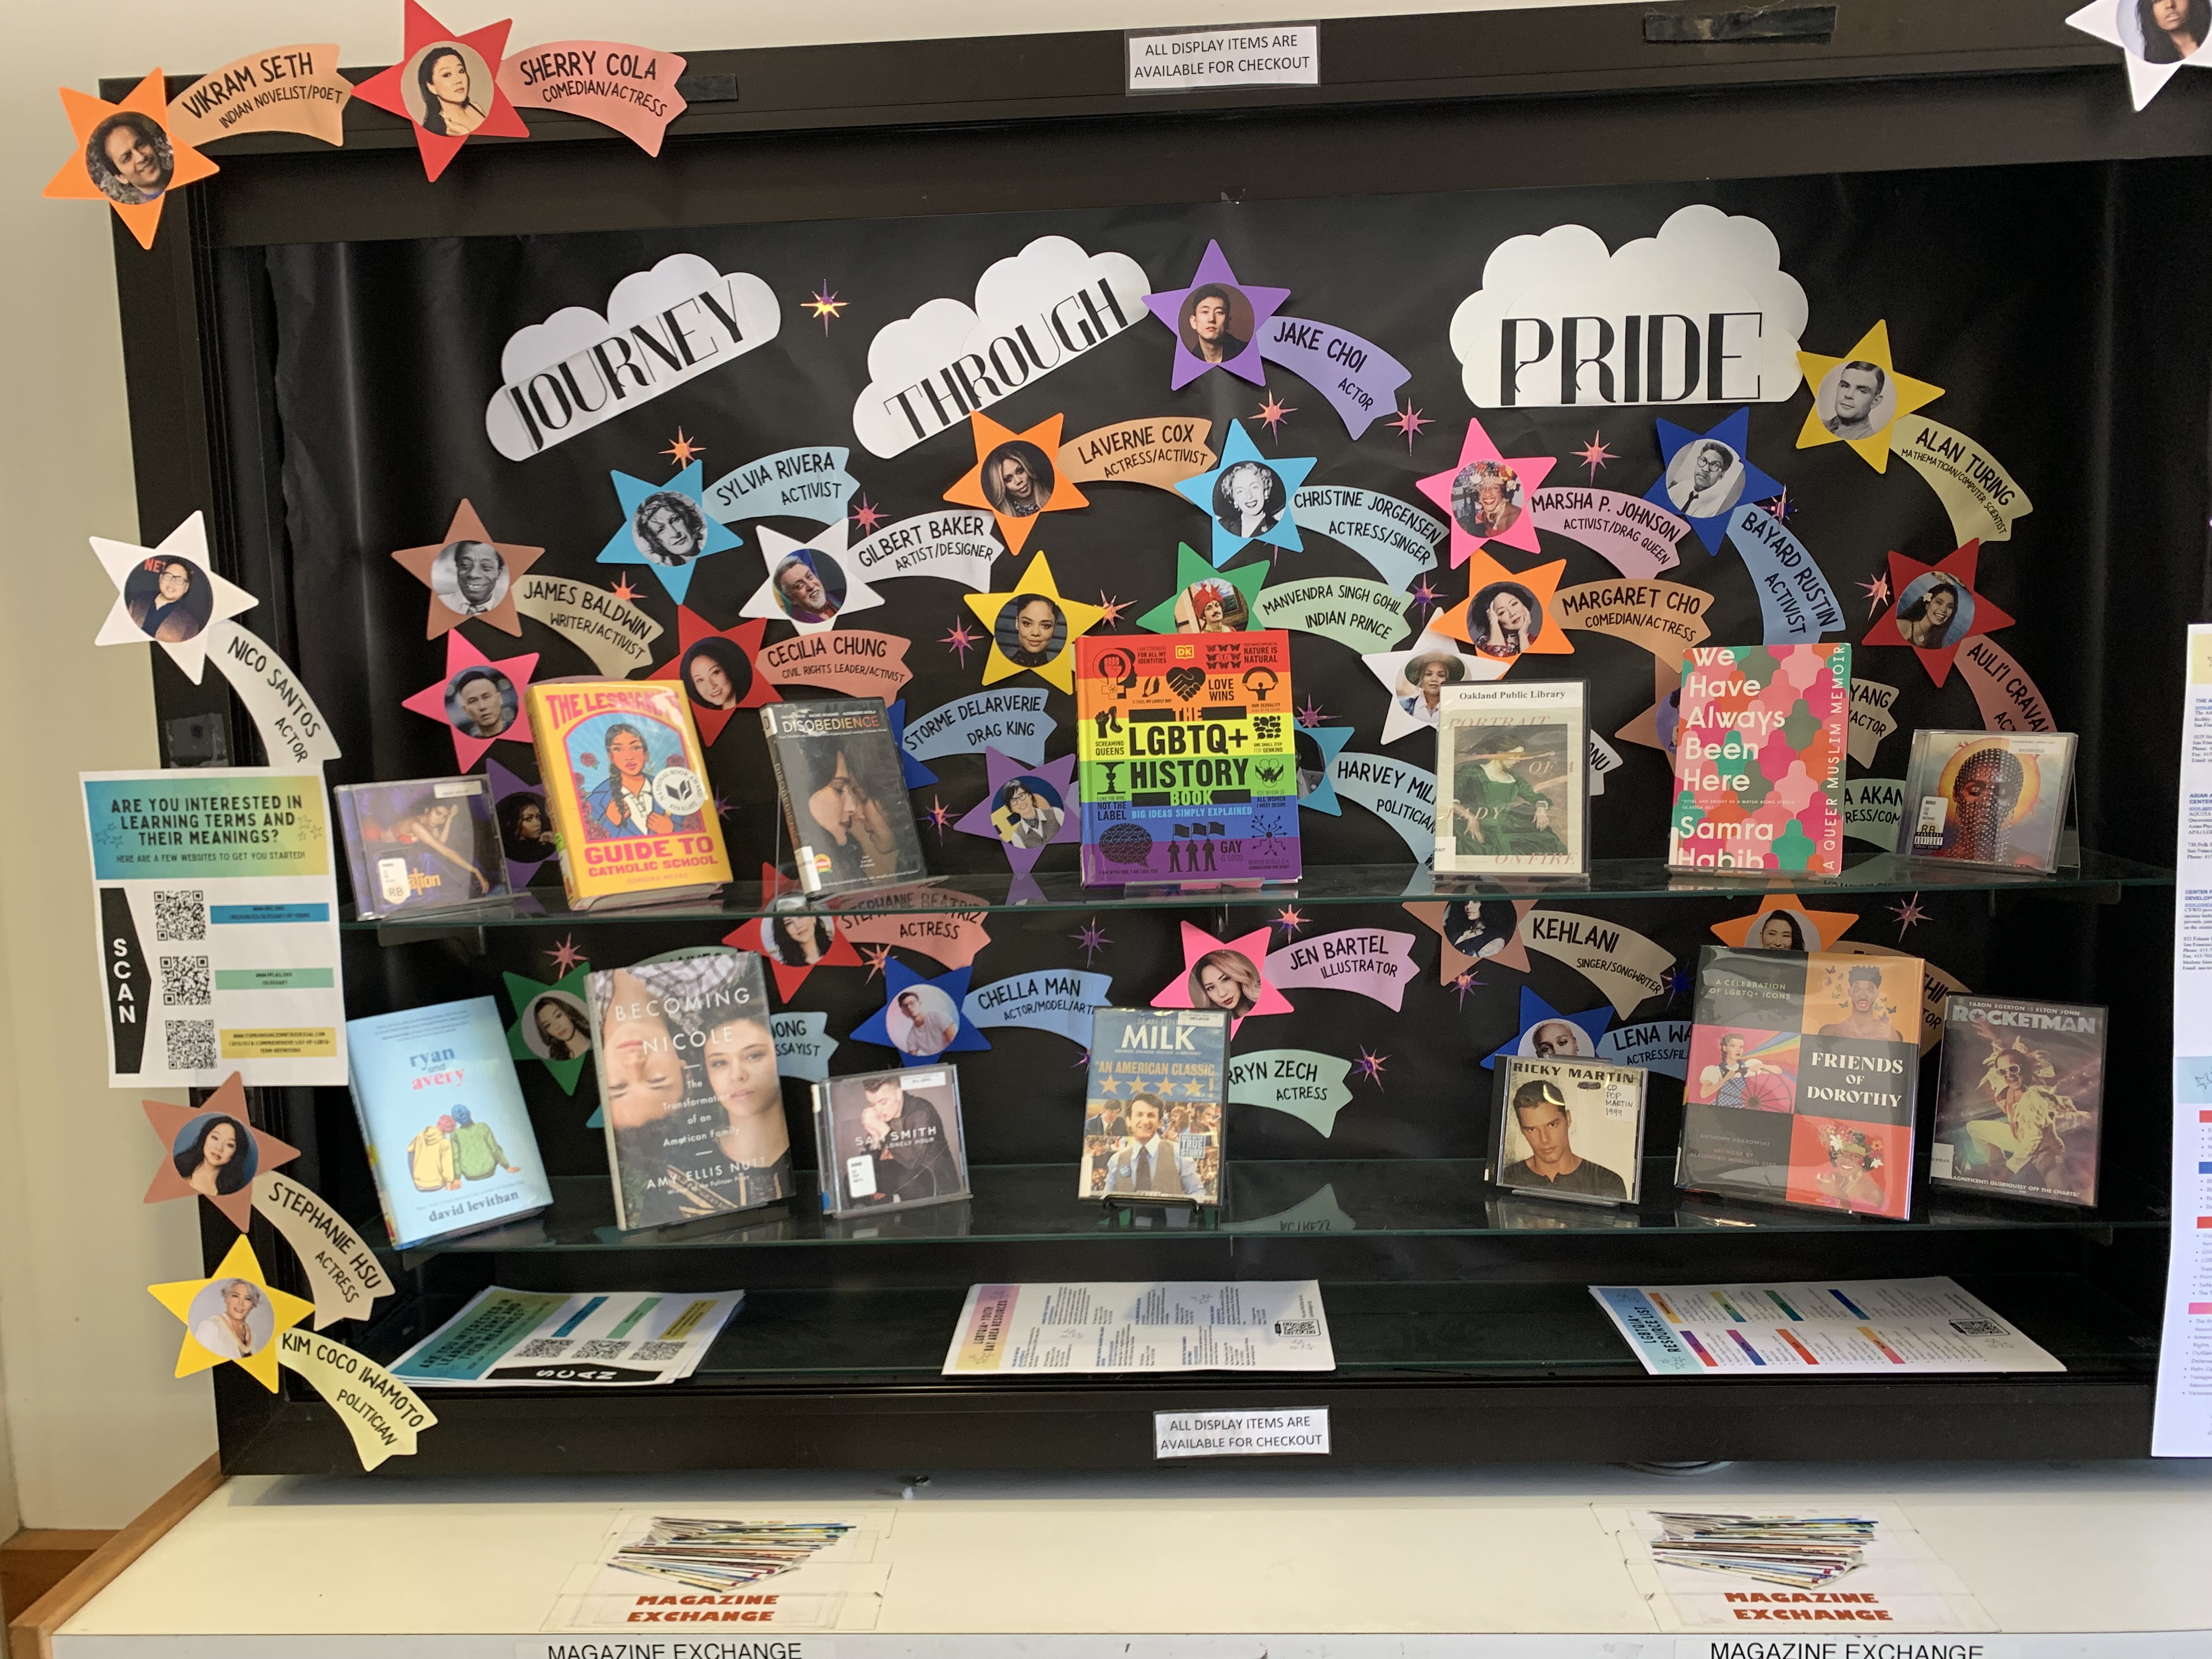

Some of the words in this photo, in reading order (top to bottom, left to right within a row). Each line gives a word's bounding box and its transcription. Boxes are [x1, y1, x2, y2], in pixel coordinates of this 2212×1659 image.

[1146, 44, 1167, 55] ALL
[1172, 39, 1223, 54] DISPLAY
[1228, 37, 1268, 49] ITEMS
[1273, 35, 1297, 47] ARE
[520, 50, 596, 87] SHERRY
[606, 52, 657, 80] COLA
[1135, 63, 1204, 77] AVAILABLE
[1209, 61, 1234, 74] FOR
[1239, 57, 1310, 71] CHECKOUT
[181, 67, 256, 120] VIKRAM
[259, 54, 313, 83] SETH
[543, 80, 667, 119] COMEDIAN/ACTRESS
[219, 103, 253, 129] INDIAN
[253, 84, 342, 114] NOVELIST/POET
[883, 278, 1128, 440] THROUGH
[1274, 321, 1321, 352] JAKE
[1327, 332, 1368, 373] CHOI
[1500, 312, 1763, 406] PRIDE
[510, 280, 743, 452] JOURNEY
[1338, 377, 1374, 411] ACTOR
[1079, 426, 1155, 465] LAVERNE
[1162, 424, 1194, 443] COX
[1103, 448, 1207, 478] ACTRESS/ACTIVIST
[1916, 427, 1966, 464] ALAN
[1965, 454, 2015, 506] TURING
[716, 467, 770, 506] SYLVIA
[775, 453, 835, 481] RIVERA
[781, 482, 842, 505] ACTIVIST
[1901, 448, 1986, 504] MATHEMATICIAN/COMPUTER
[1983, 502, 2006, 535] SCIENTIST
[1294, 492, 1363, 509] CHRISTINE
[1368, 498, 1443, 545] JORGENSEN
[1531, 493, 1593, 512] MARSHA
[1598, 496, 1611, 512] P.
[1616, 501, 1680, 543] JOHNSON
[859, 526, 923, 567] GILBERT
[931, 515, 984, 540] BAKER
[1328, 521, 1431, 566] ACTRESS/SINGER
[1564, 518, 1639, 543] ACTIVIST/DRAG
[1640, 537, 1671, 565] QUEEN
[895, 544, 994, 572] ARTIST/DESIGNER
[1741, 511, 1802, 569] BAYARD
[1793, 566, 1839, 628] RUSTIN
[523, 580, 576, 605] JAMES
[581, 590, 652, 640] BALDWIN
[1262, 585, 1333, 616] MANVENDRA
[1338, 585, 1370, 601] SINGH
[1373, 592, 1403, 616] GOHIL
[1562, 586, 1662, 616] MARGARET
[1666, 591, 1701, 615] CHO
[1764, 572, 1807, 634] ACTIVIST
[550, 612, 646, 659] WRITER/ACTIVIST
[1305, 612, 1346, 629] INDIAN
[1351, 614, 1393, 640] PRINCE
[1585, 613, 1696, 641] COMEDIAN/ACTRESS
[768, 639, 827, 667] CECILIA
[834, 637, 887, 658] CHUNG
[1244, 654, 1278, 663] NATURAL
[1692, 648, 1735, 667] We
[227, 636, 266, 672] NICO
[267, 669, 321, 737] SANTOS
[782, 667, 801, 679] CIVIL
[803, 664, 832, 675] RIGHTS
[834, 664, 905, 683] LEADER/ACTIVIST
[1209, 679, 1234, 690] LOVE
[1689, 675, 1760, 697] Have
[1831, 646, 1845, 713] MEMOIR
[1210, 691, 1234, 701] WINS
[1459, 691, 1497, 701] Oakland
[1500, 691, 1528, 699] Public
[1530, 690, 1565, 699] Library
[782, 715, 879, 732] DISOBEDIENCE
[904, 708, 956, 751] STORME
[961, 695, 1041, 720] DELARVERIE
[967, 723, 1002, 746] DRAG
[1006, 721, 1034, 736] KING
[1686, 707, 1785, 735] Always
[274, 717, 308, 763] ACTOR
[1096, 747, 1124, 756] QUEENS
[1128, 724, 1248, 756] LGBTQ+
[1685, 738, 1758, 760] Been
[1827, 723, 1842, 789] MUSLIM
[1131, 759, 1249, 789] HISTORY
[1684, 768, 1750, 791] Here
[111, 799, 142, 813] ARE
[149, 797, 180, 812] YOU
[185, 795, 281, 810] INTERESTED
[286, 795, 302, 809] IN
[1132, 810, 1147, 819] BIG
[1148, 809, 1174, 819] IDEAS
[1176, 809, 1205, 817] SIMPLY
[1208, 807, 1252, 816] EXPLAINED
[1171, 791, 1213, 806] BOOK
[121, 813, 199, 830] LEARNING
[204, 812, 256, 827] TERMS
[263, 812, 295, 826] AND
[1679, 816, 1773, 839] Samra
[1824, 798, 1838, 850] QUEER
[138, 832, 184, 846] THEIR
[189, 829, 278, 844] MEANINGS?
[584, 840, 673, 865] GUIDE
[678, 836, 714, 855] TO
[588, 861, 658, 877] CATHOLIC
[662, 856, 719, 869] SCHOOL
[1679, 847, 1764, 868] Habib
[1822, 860, 1834, 870] A
[1533, 917, 1620, 953] KEHLANI
[1290, 950, 1319, 971] JEN
[1324, 935, 1389, 960] BARTEL
[112, 938, 136, 1023] SCAN
[1321, 959, 1397, 980] ILLUSTRATOR
[1577, 957, 1661, 995] SINGER/SONGWRITER
[978, 979, 1038, 1010] CHELLA
[1045, 979, 1081, 997] MAN
[1724, 980, 1786, 990] CELEBRATION
[1725, 989, 1758, 997] LGBTQ+
[615, 988, 750, 1021] BECOMING
[1952, 1005, 2095, 1034] ROCKETMAN
[643, 1026, 733, 1055] NICOLE
[1121, 1025, 1196, 1050] MILK
[409, 1047, 456, 1070] ryan
[1514, 1063, 1561, 1076] RICKY
[1569, 1069, 1634, 1083] MARTIN
[1811, 1052, 1903, 1074] FRIENDS
[413, 1069, 464, 1090] avery
[1846, 1075, 1864, 1085] OF
[1807, 1086, 1902, 1107] DOROTHY
[1606, 1108, 1622, 1116] 1999
[429, 1204, 464, 1222] david
[467, 1191, 518, 1212] levithan
[269, 1182, 356, 1255] STEPHANIE
[349, 1252, 382, 1289] HSU
[315, 1251, 359, 1303] ACTRESS
[281, 1333, 311, 1355] KIM
[317, 1344, 357, 1373] COCO
[358, 1367, 424, 1427] IWAMOTO
[337, 1389, 397, 1446] POLITICIAN
[1170, 1420, 1191, 1431] ALL
[1195, 1419, 1243, 1430] DISPLAY
[1246, 1417, 1283, 1429] ITEMS
[1287, 1417, 1311, 1427] ARE
[1161, 1438, 1225, 1449] AVAILABLE
[1229, 1437, 1252, 1447] FOR
[1256, 1435, 1322, 1446] CHECKOUT
[636, 1595, 779, 1605] MAGAZINE
[1723, 1593, 1878, 1602] MAGAZINE
[627, 1611, 775, 1621] EXCHANGE
[1734, 1610, 1893, 1620] EXCHANGE
